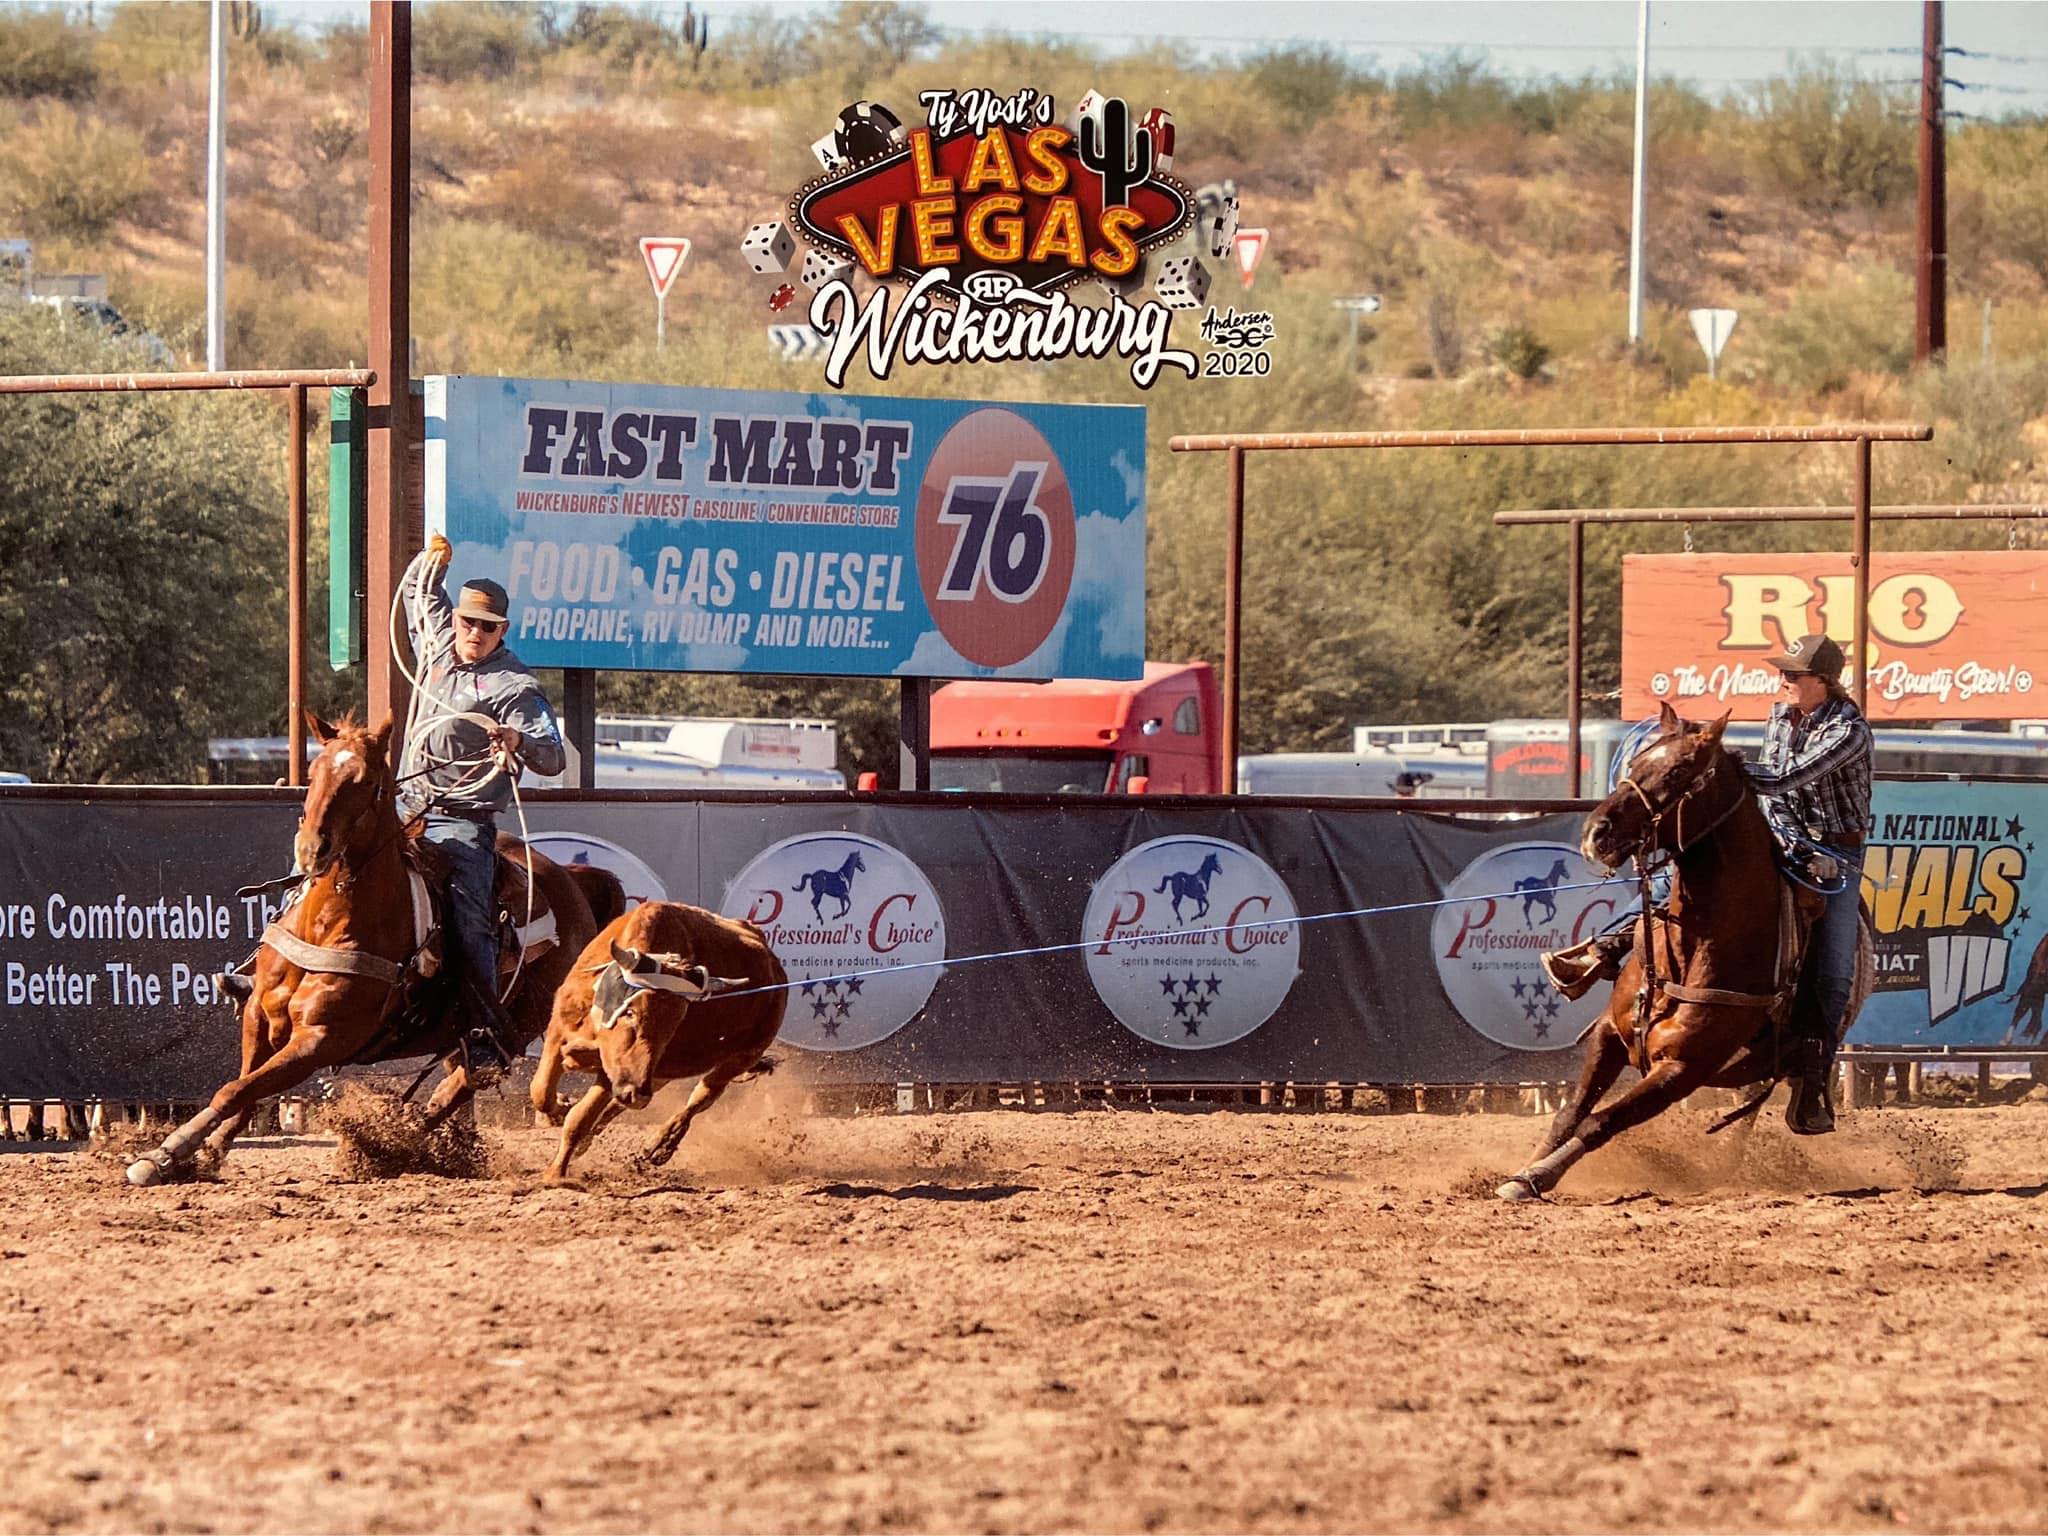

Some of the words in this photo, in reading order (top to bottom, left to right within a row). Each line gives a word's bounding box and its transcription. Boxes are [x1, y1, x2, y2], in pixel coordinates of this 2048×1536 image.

[522, 406, 697, 480] FAST
[708, 418, 910, 490] MART
[516, 491, 618, 514] WICKENBURG'S
[622, 491, 690, 519] NEWEST
[693, 500, 756, 521] GASOLINE
[767, 504, 856, 525] CONVENIENCE
[859, 507, 899, 526] STORE
[937, 461, 1053, 601] 76
[508, 541, 620, 603] FOOD
[653, 546, 738, 607] GAS
[770, 551, 905, 611] DIESEL
[520, 607, 634, 649] PROPANE,
[641, 610, 674, 643] RV
[678, 612, 750, 646] DUMP
[753, 613, 802, 647] AND
[806, 615, 889, 649] MORE...
[1718, 573, 1966, 649] RIO
[1673, 665, 1706, 695] The
[1708, 663, 1782, 701] Nation
[1872, 660, 1953, 702] Bounty
[1883, 814, 2001, 842] NATIONAL
[1860, 844, 2027, 935] NALS
[47, 893, 231, 940] Comfortable
[747, 890, 862, 950] Pofessional's
[868, 894, 935, 953] Choice
[1094, 891, 1219, 955] Professional's
[1225, 896, 1289, 954] Choice
[1443, 897, 1567, 958] Professional's
[7, 962, 97, 1005] Better
[106, 962, 161, 1005] The
[791, 957, 833, 967] medicine
[1153, 957, 1193, 967] medicine
[1872, 954, 1920, 971] RIAT
[1927, 935, 2010, 1025] VII
